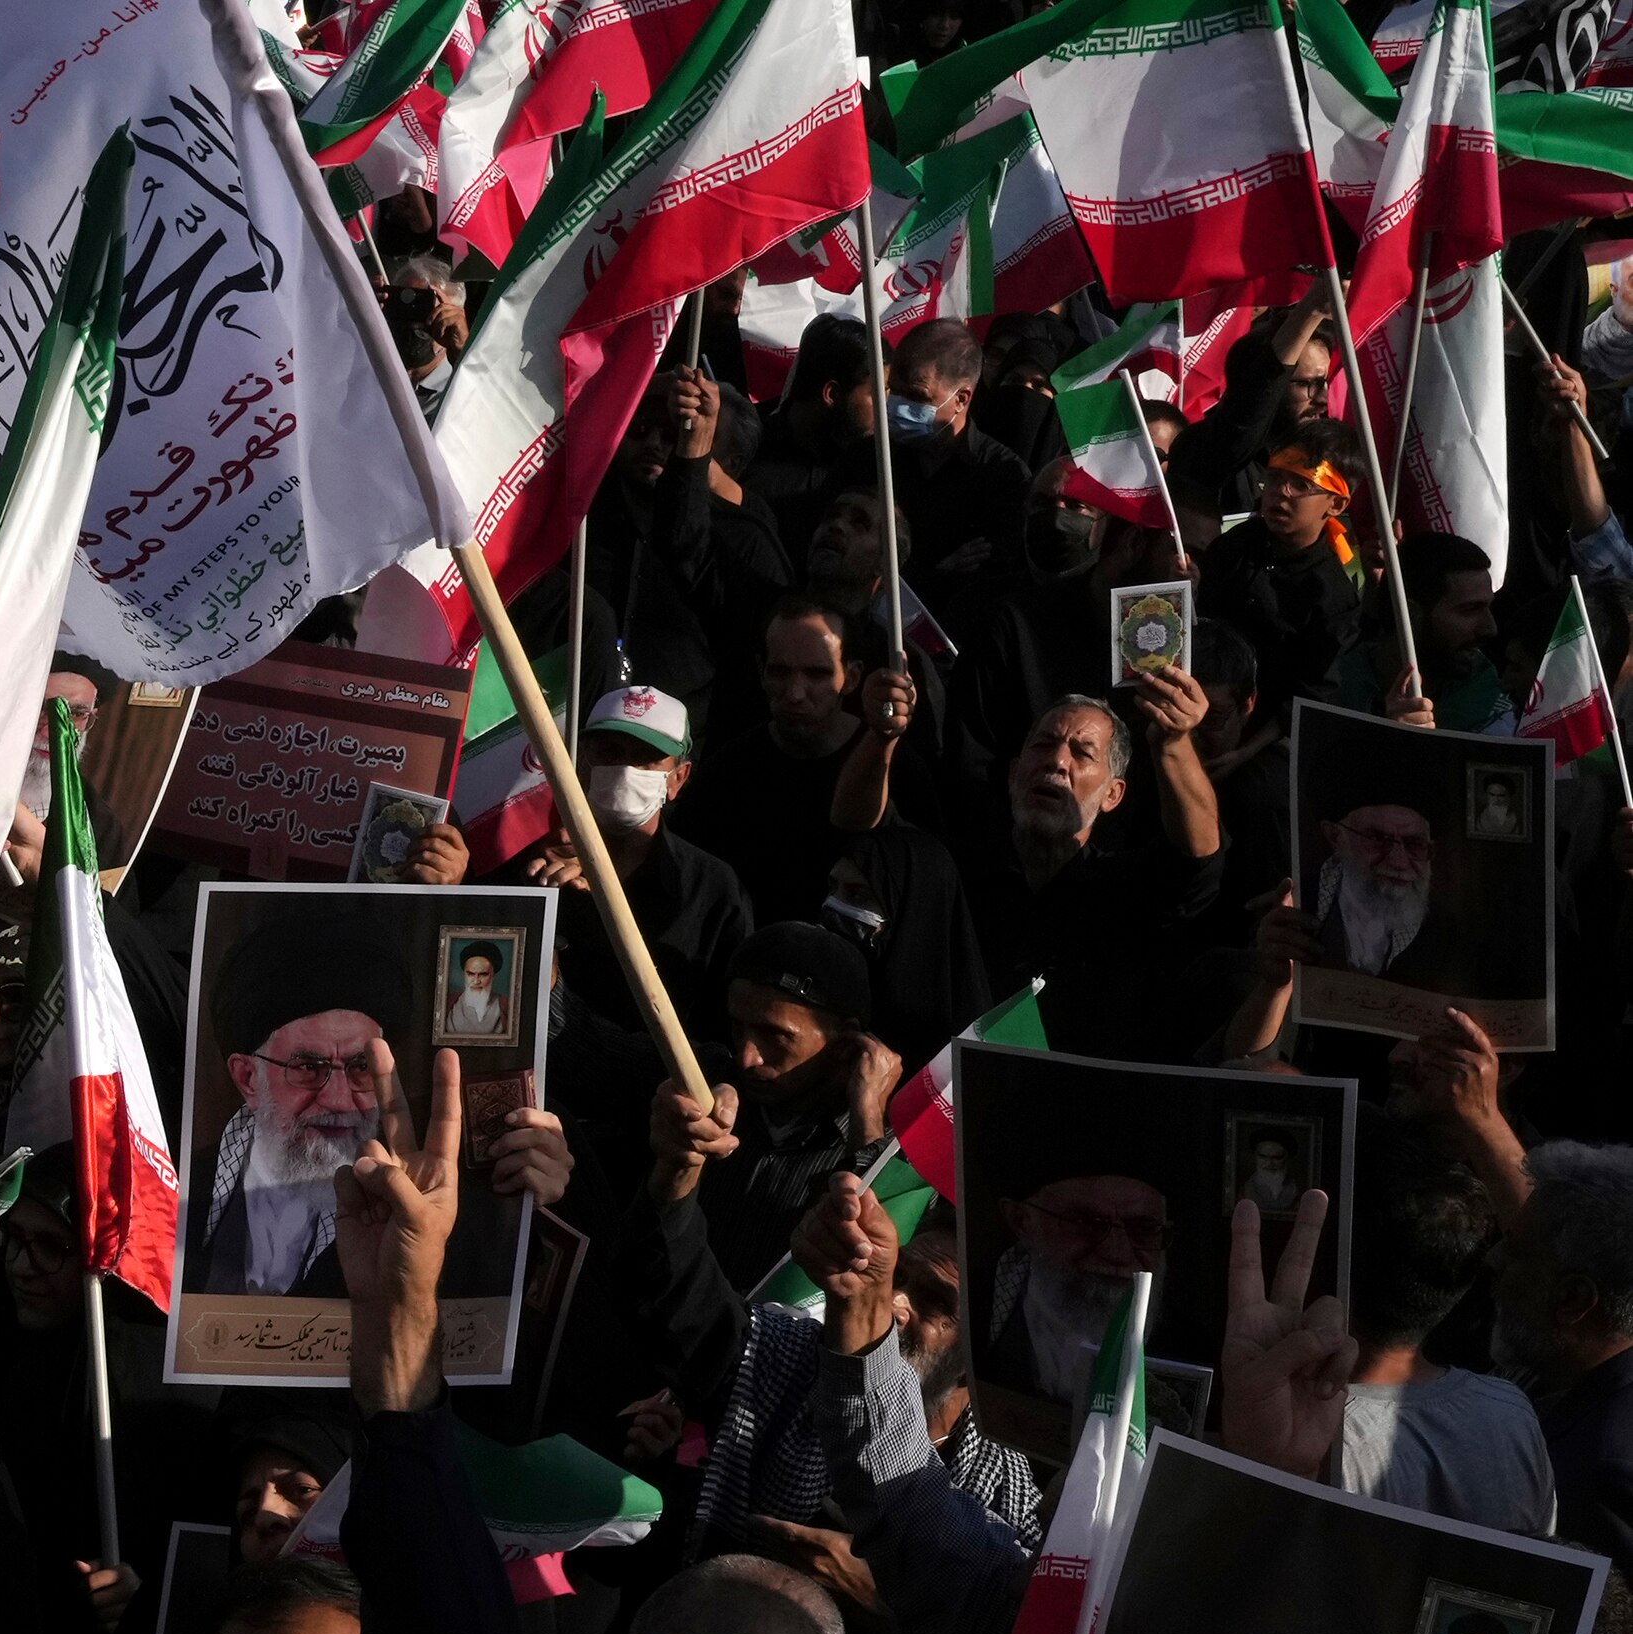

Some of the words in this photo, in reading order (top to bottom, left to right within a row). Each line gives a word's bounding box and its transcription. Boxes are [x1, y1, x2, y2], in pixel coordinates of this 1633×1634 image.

[162, 576, 192, 602] MY
[190, 534, 239, 578] STEPS
[235, 513, 261, 535] TO
[258, 475, 301, 513] YOUR
[340, 681, 383, 702] رهبری
[384, 685, 420, 704] معظم
[420, 690, 451, 710] مقام
[222, 716, 266, 744] نمی
[269, 722, 329, 757] اجازه
[197, 752, 236, 778] فتنه
[237, 763, 321, 798] آلودگی
[315, 774, 361, 806] غبار
[187, 794, 226, 820] کند
[227, 801, 286, 834] گمراه
[287, 811, 307, 846] را
